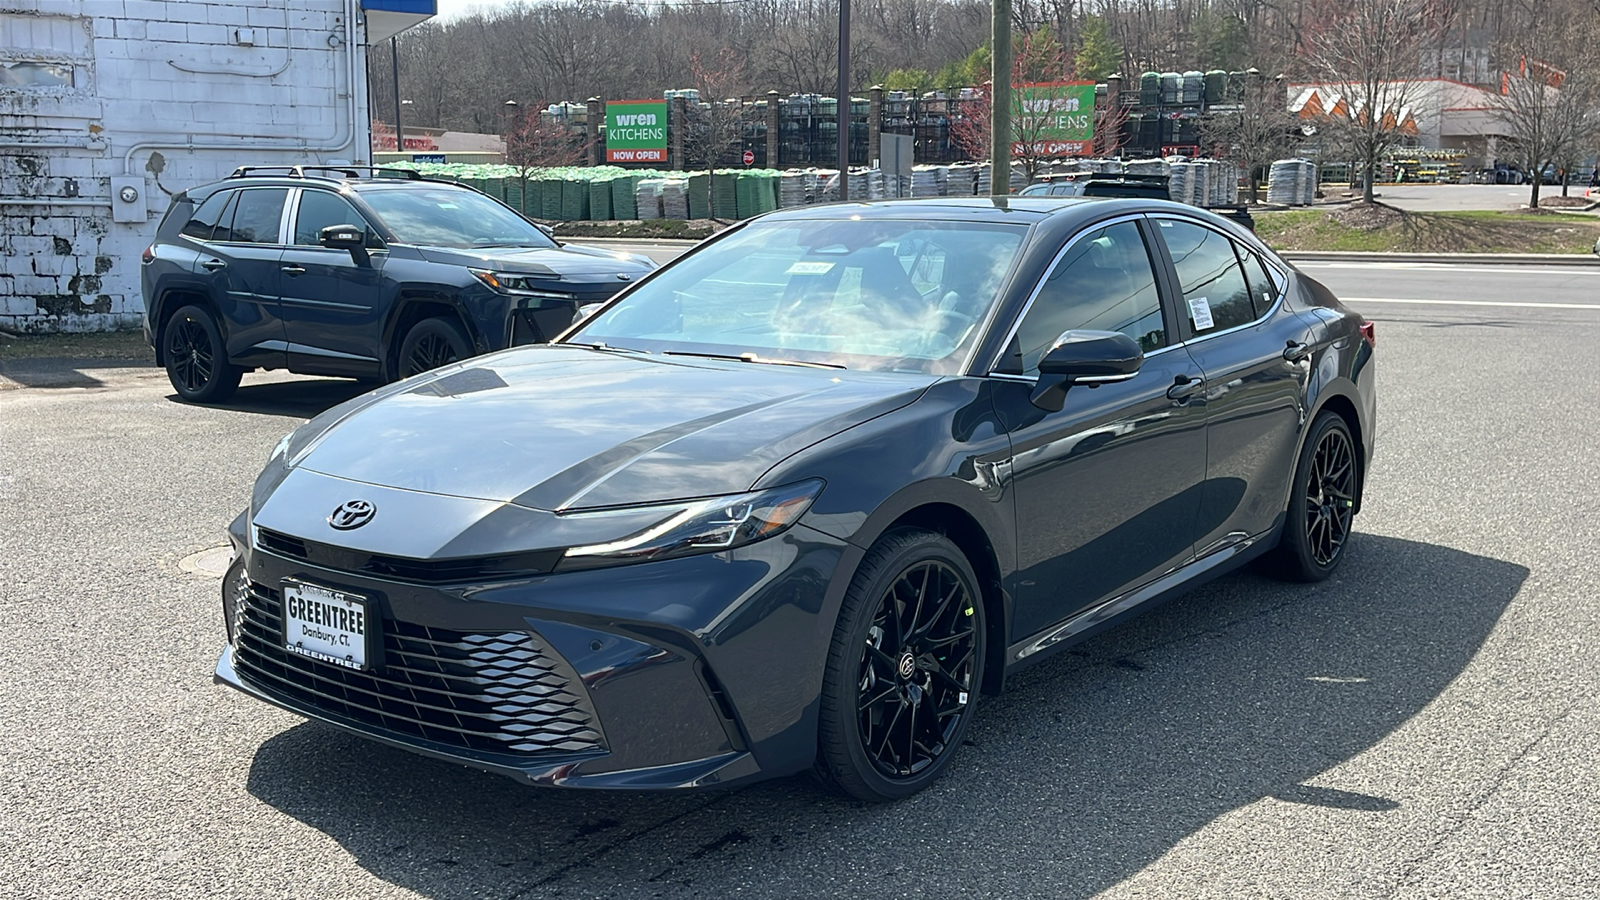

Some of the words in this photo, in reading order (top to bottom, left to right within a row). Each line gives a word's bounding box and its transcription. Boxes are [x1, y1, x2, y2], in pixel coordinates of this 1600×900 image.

[615, 113, 657, 127] wren
[609, 128, 663, 141] KITCHENS
[613, 151, 635, 160] NOW
[636, 151, 660, 160] OPEN
[288, 595, 364, 636] GREENTREE
[302, 624, 338, 646] Danbury,
[286, 644, 361, 671] GREENTREE
